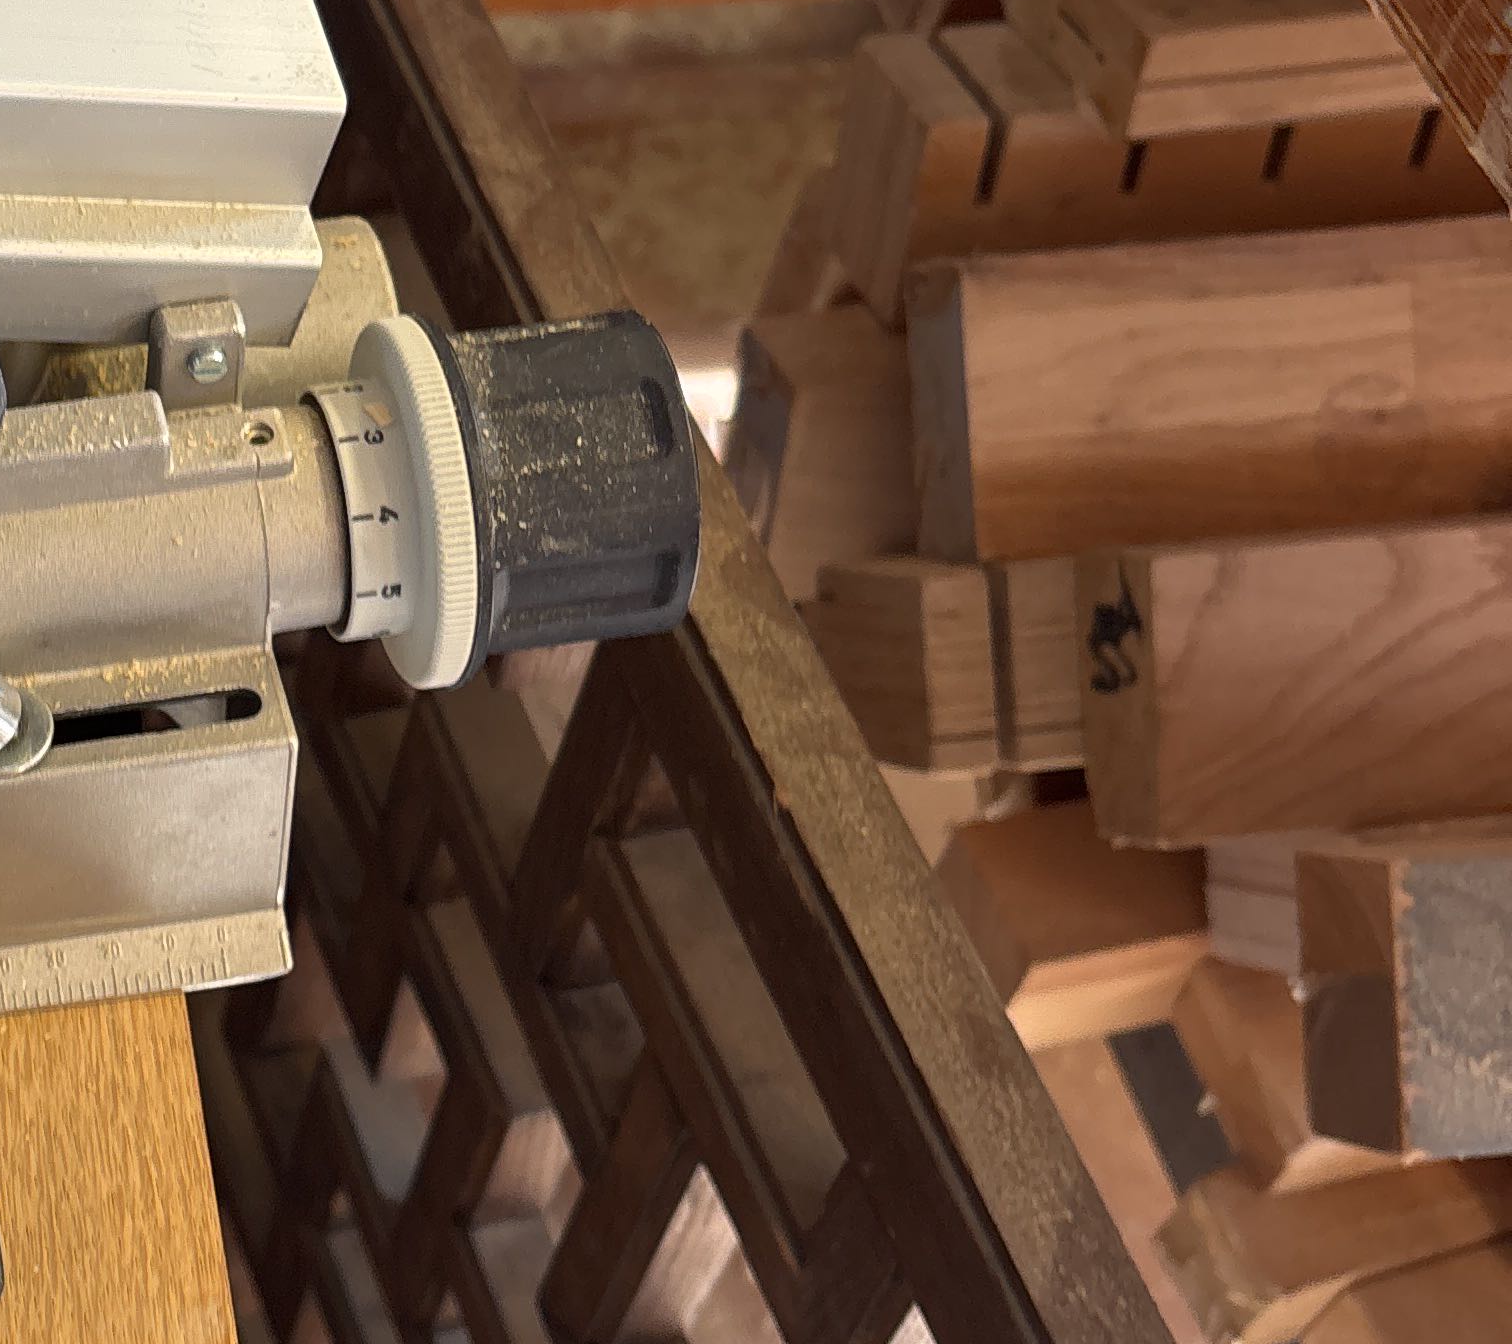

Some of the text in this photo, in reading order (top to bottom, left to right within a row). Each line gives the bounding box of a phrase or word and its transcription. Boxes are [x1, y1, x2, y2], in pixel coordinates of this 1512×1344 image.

[364, 429, 384, 445] 3
[379, 505, 399, 526] 4
[381, 583, 402, 600] 5
